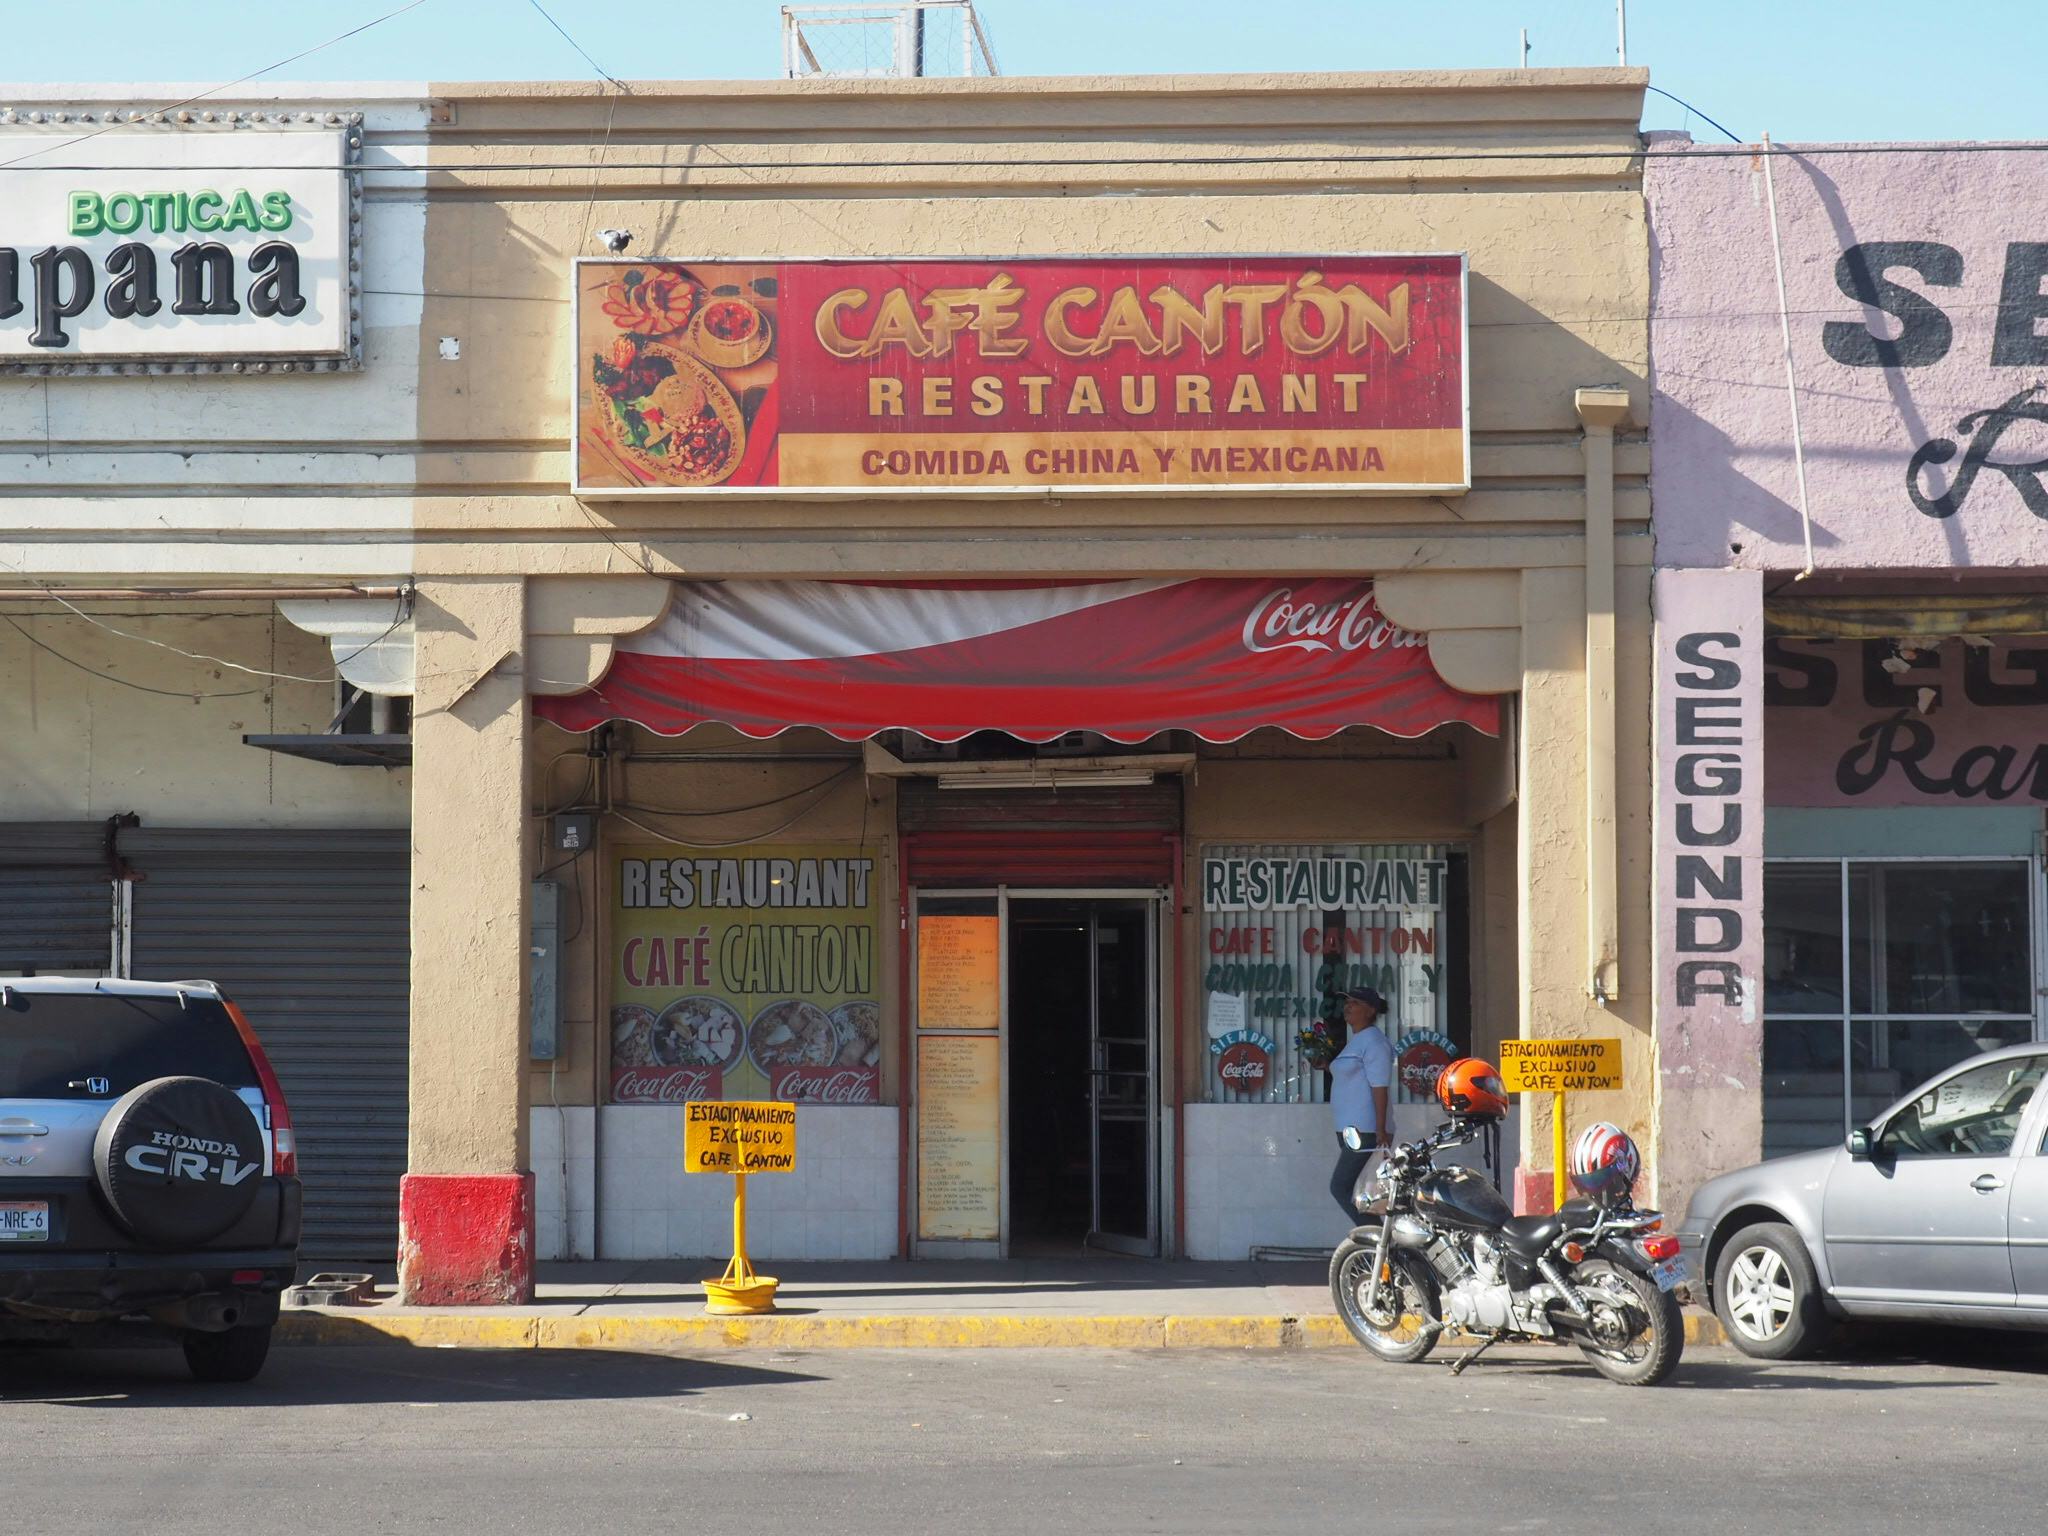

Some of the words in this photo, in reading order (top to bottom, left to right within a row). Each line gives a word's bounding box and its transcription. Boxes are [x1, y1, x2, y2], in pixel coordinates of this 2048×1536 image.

[67, 189, 293, 236] BOTICAS
[815, 272, 1029, 359] CAFÉ
[1043, 269, 1410, 357] CANTÓN
[868, 373, 1368, 416] RESTAURANT
[861, 449, 1010, 476] COMIDA
[1025, 448, 1140, 475] CHINA
[1153, 448, 1175, 473] Y
[1190, 446, 1385, 473] MEXICANA
[1675, 632, 1743, 1007] SEGUNDA
[621, 858, 873, 909] RESTAURANT
[1204, 858, 1447, 912] RESTAURANT
[1208, 927, 1276, 955] CAFE
[1303, 927, 1433, 954] CANTON
[622, 927, 711, 988] CAFÉ
[720, 924, 871, 994] CANTON
[1204, 963, 1293, 993] COMIDA
[1315, 963, 1395, 993] CHINA
[1421, 964, 1444, 993] Y
[1254, 996, 1347, 1018] MEXIC
[1210, 1030, 1274, 1056] SIEMPRE
[1394, 1031, 1456, 1056] SIEMPRE
[1500, 1043, 1604, 1058] ESTACIONAMIENTO
[1222, 1062, 1264, 1078] Coca-Cola
[152, 1131, 240, 1157] HONDA
[700, 1151, 732, 1166] CAFE
[124, 1144, 260, 1186] CR-V
